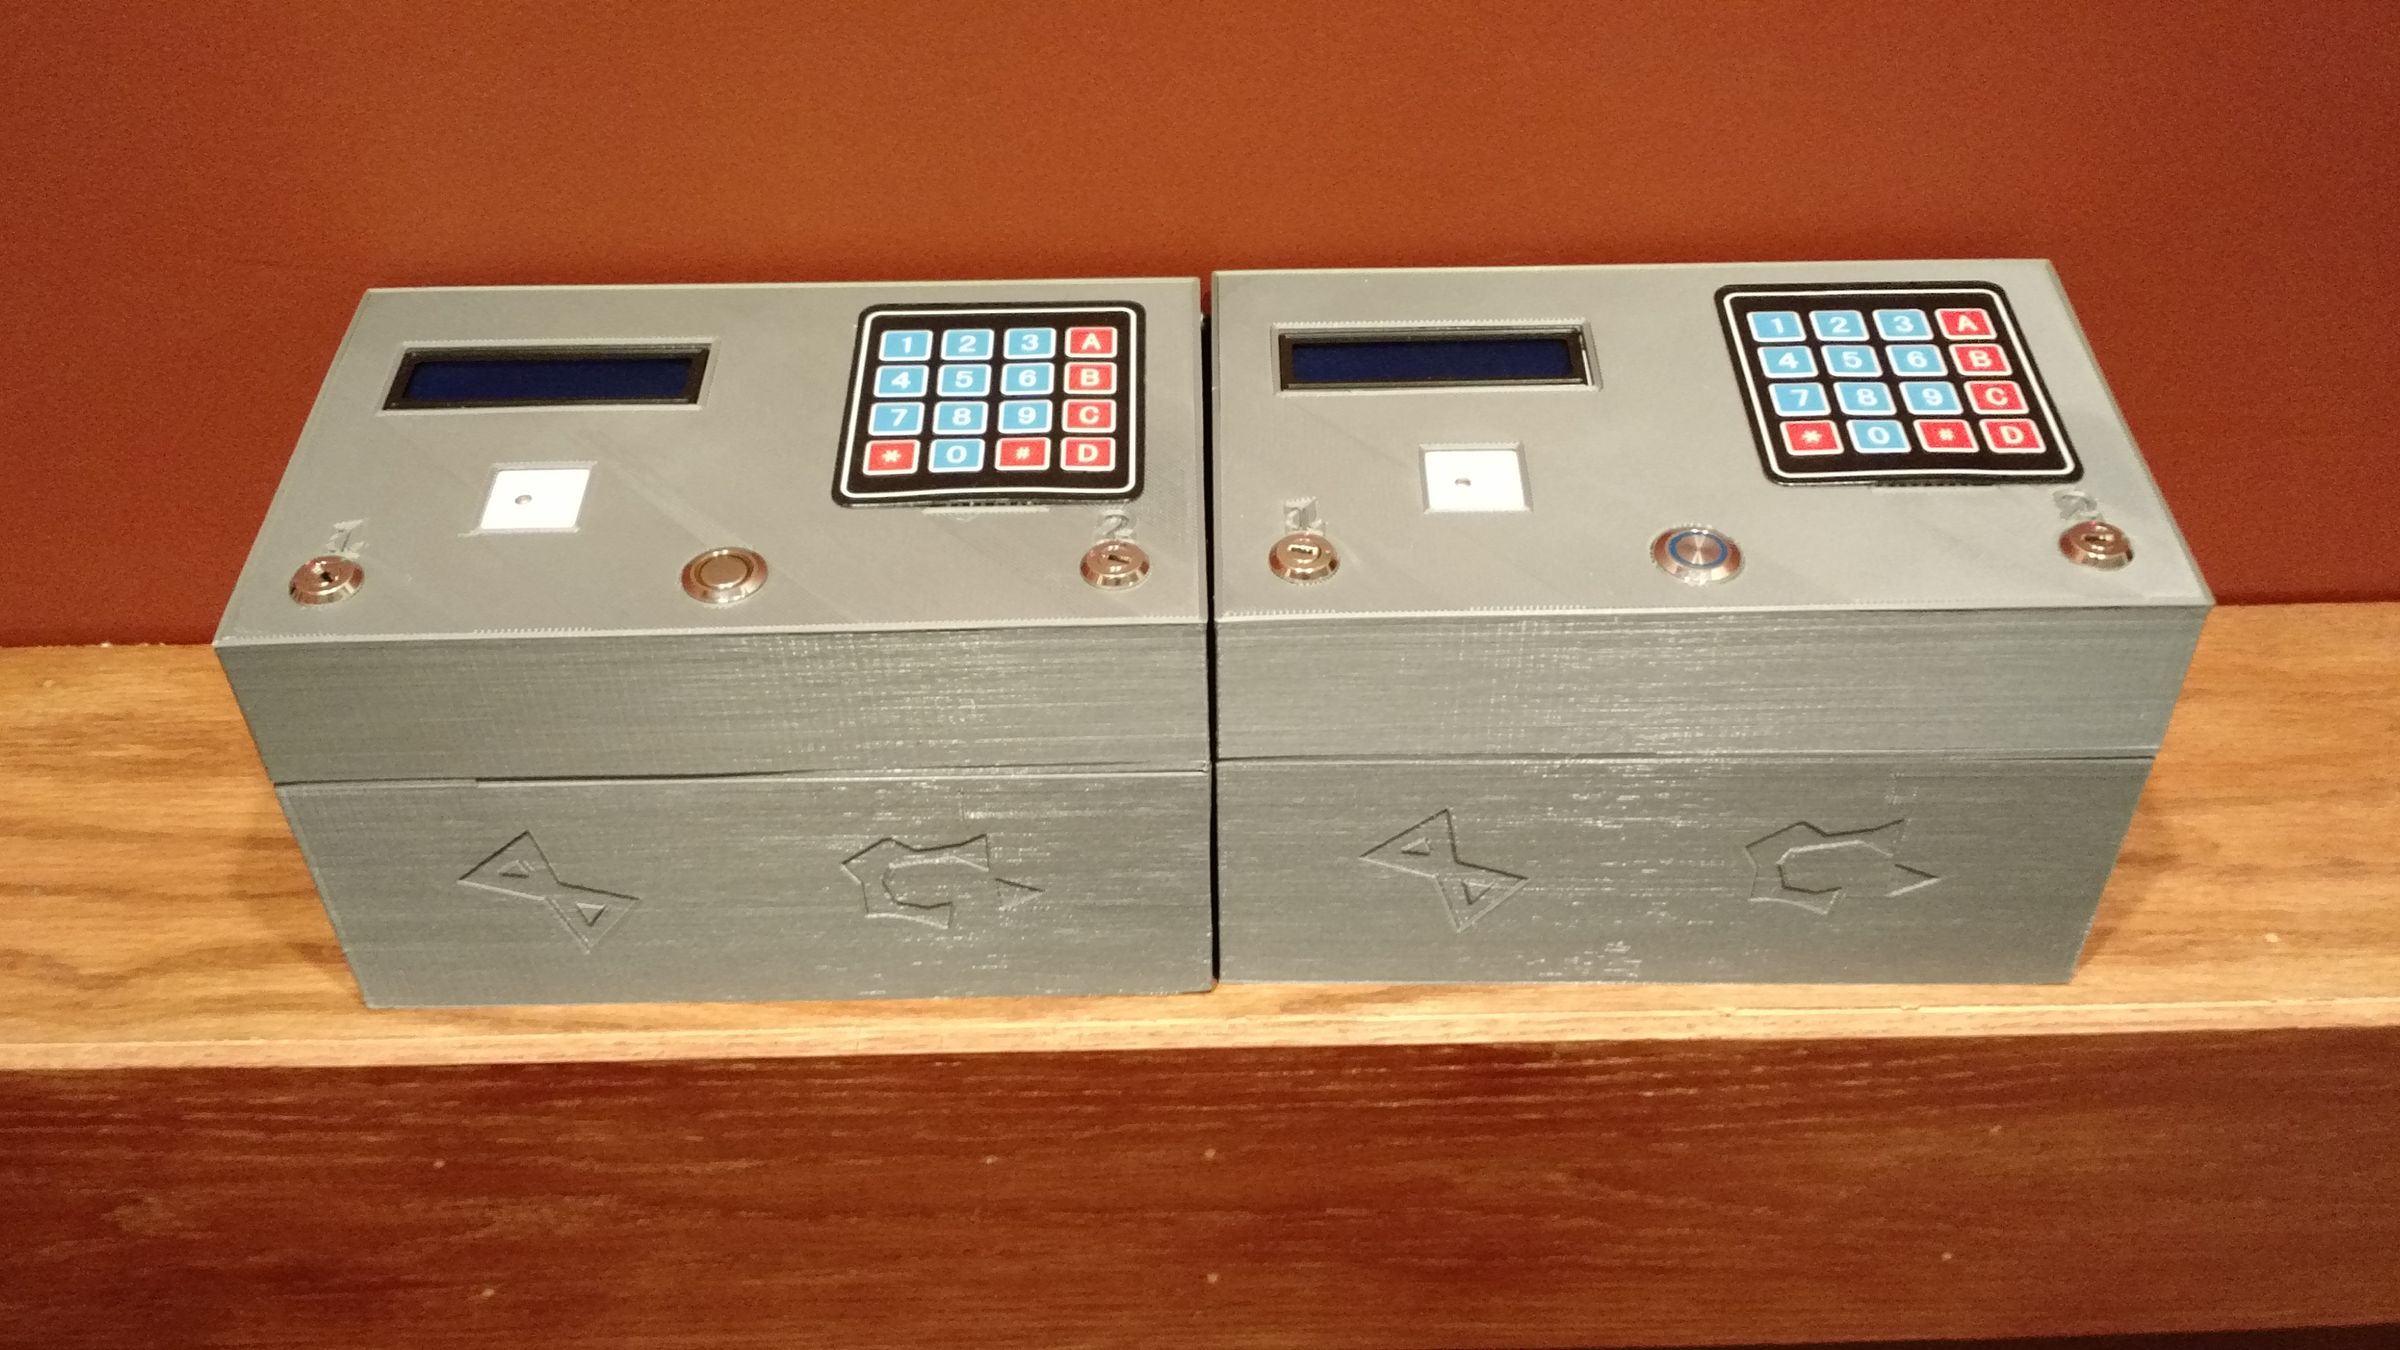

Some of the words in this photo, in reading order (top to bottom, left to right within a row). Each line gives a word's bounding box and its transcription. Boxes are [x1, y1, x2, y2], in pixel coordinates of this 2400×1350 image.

[1770, 317, 1785, 334] 1
[1829, 316, 1850, 334] 2
[1893, 315, 1914, 333] 3
[1957, 314, 1979, 332] A
[901, 336, 913, 353] 1
[958, 334, 977, 353] 2
[1021, 333, 1039, 352] 3
[1081, 332, 1102, 351] A
[1778, 352, 1799, 369] 4
[1842, 351, 1863, 369] 5
[1906, 350, 1928, 369] 6
[1968, 349, 1992, 368] B
[891, 371, 911, 389] 4
[955, 370, 974, 388] 5
[1018, 369, 1037, 388] 6
[1080, 368, 1100, 387] B
[1790, 388, 1809, 407] 7
[1856, 388, 1878, 407] 8
[1922, 387, 1944, 407] 9
[1985, 387, 2009, 407] C
[891, 407, 908, 427] 7
[952, 407, 972, 426] 8
[1017, 406, 1037, 425] 9
[1079, 405, 1100, 425] C
[1867, 426, 1890, 445] 0
[1999, 425, 2025, 445] D
[946, 445, 967, 464] 0
[1077, 443, 1099, 463] D
